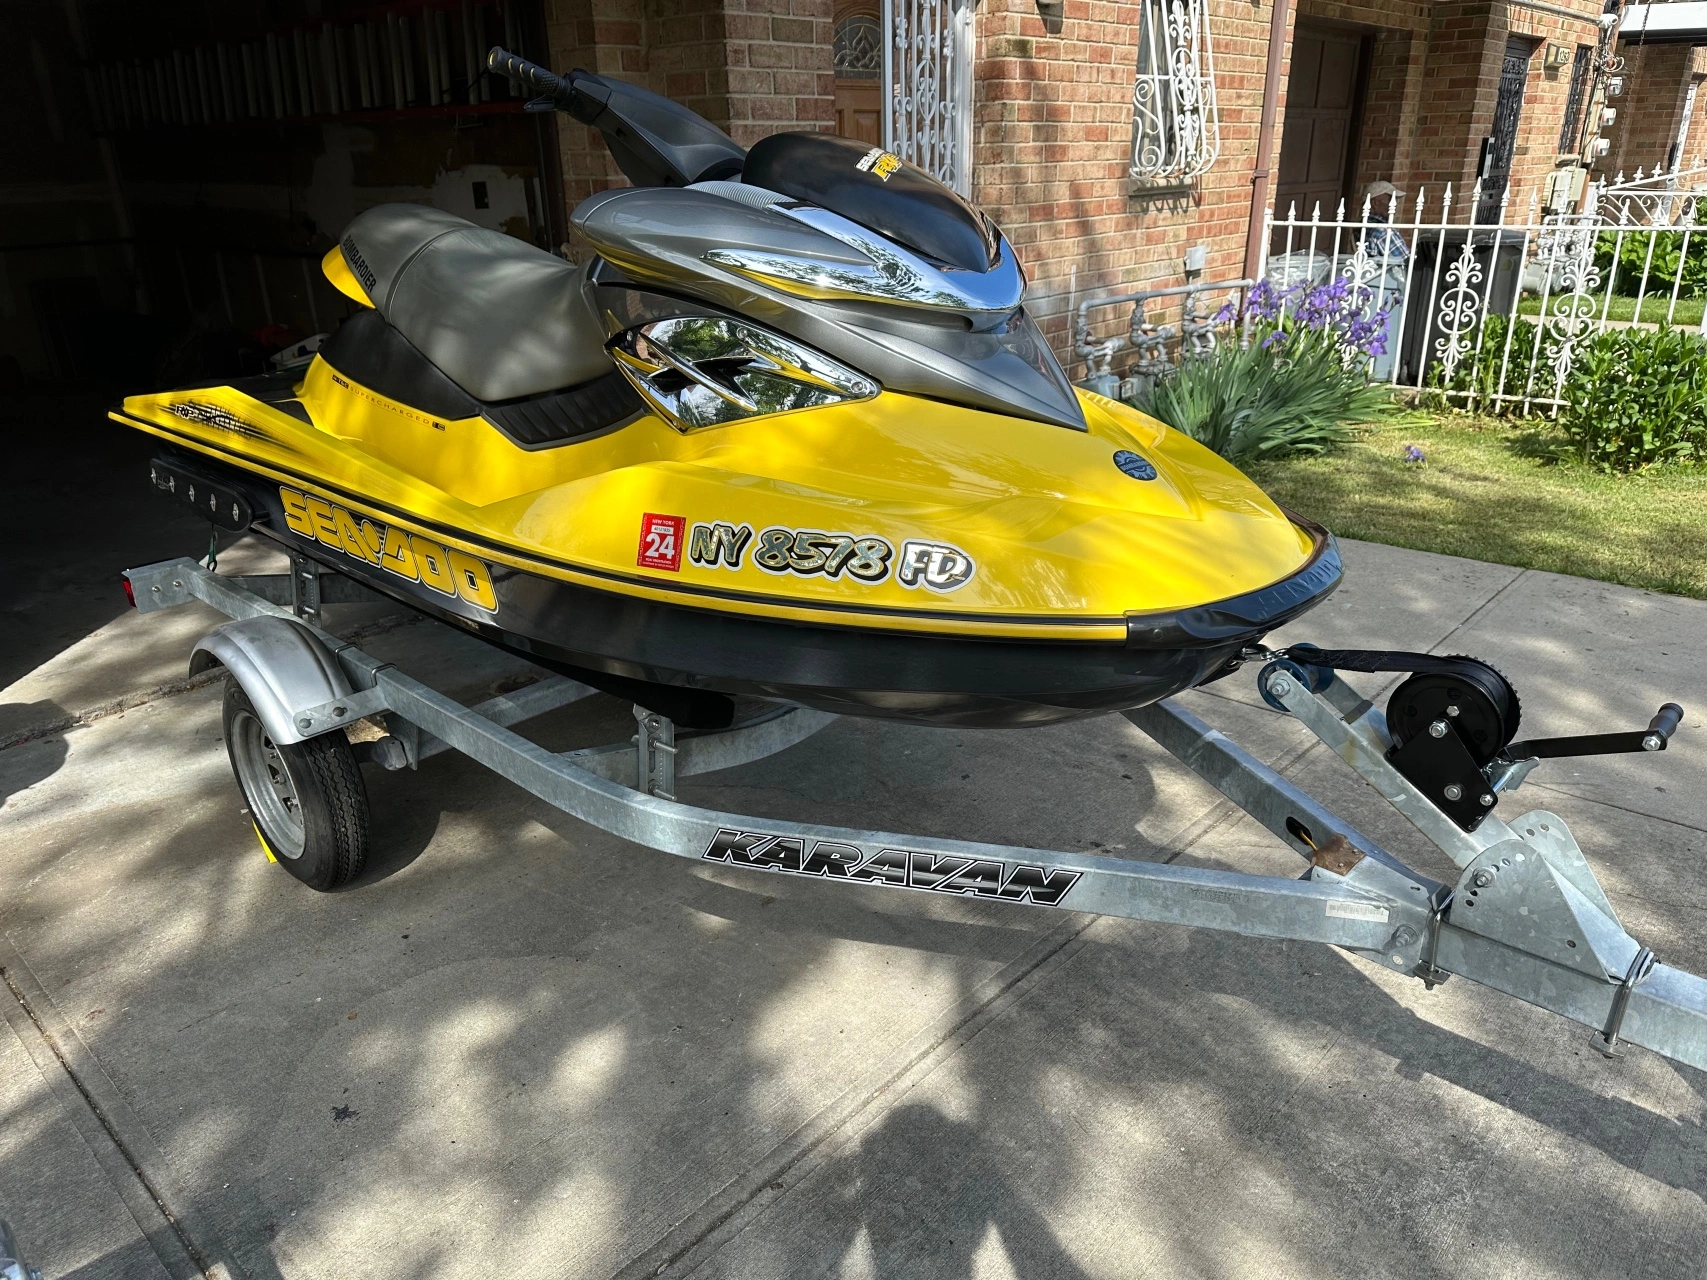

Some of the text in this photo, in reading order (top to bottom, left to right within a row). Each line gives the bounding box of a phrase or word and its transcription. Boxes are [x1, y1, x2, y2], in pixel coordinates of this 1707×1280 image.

[343, 235, 377, 293] BOMBARDIER
[350, 386, 430, 424] SUPERCHARGED
[644, 533, 675, 559] 24
[692, 522, 753, 570] NY
[754, 527, 895, 585] 8578
[898, 539, 975, 592] FD
[702, 828, 1083, 906] KARAVAN
